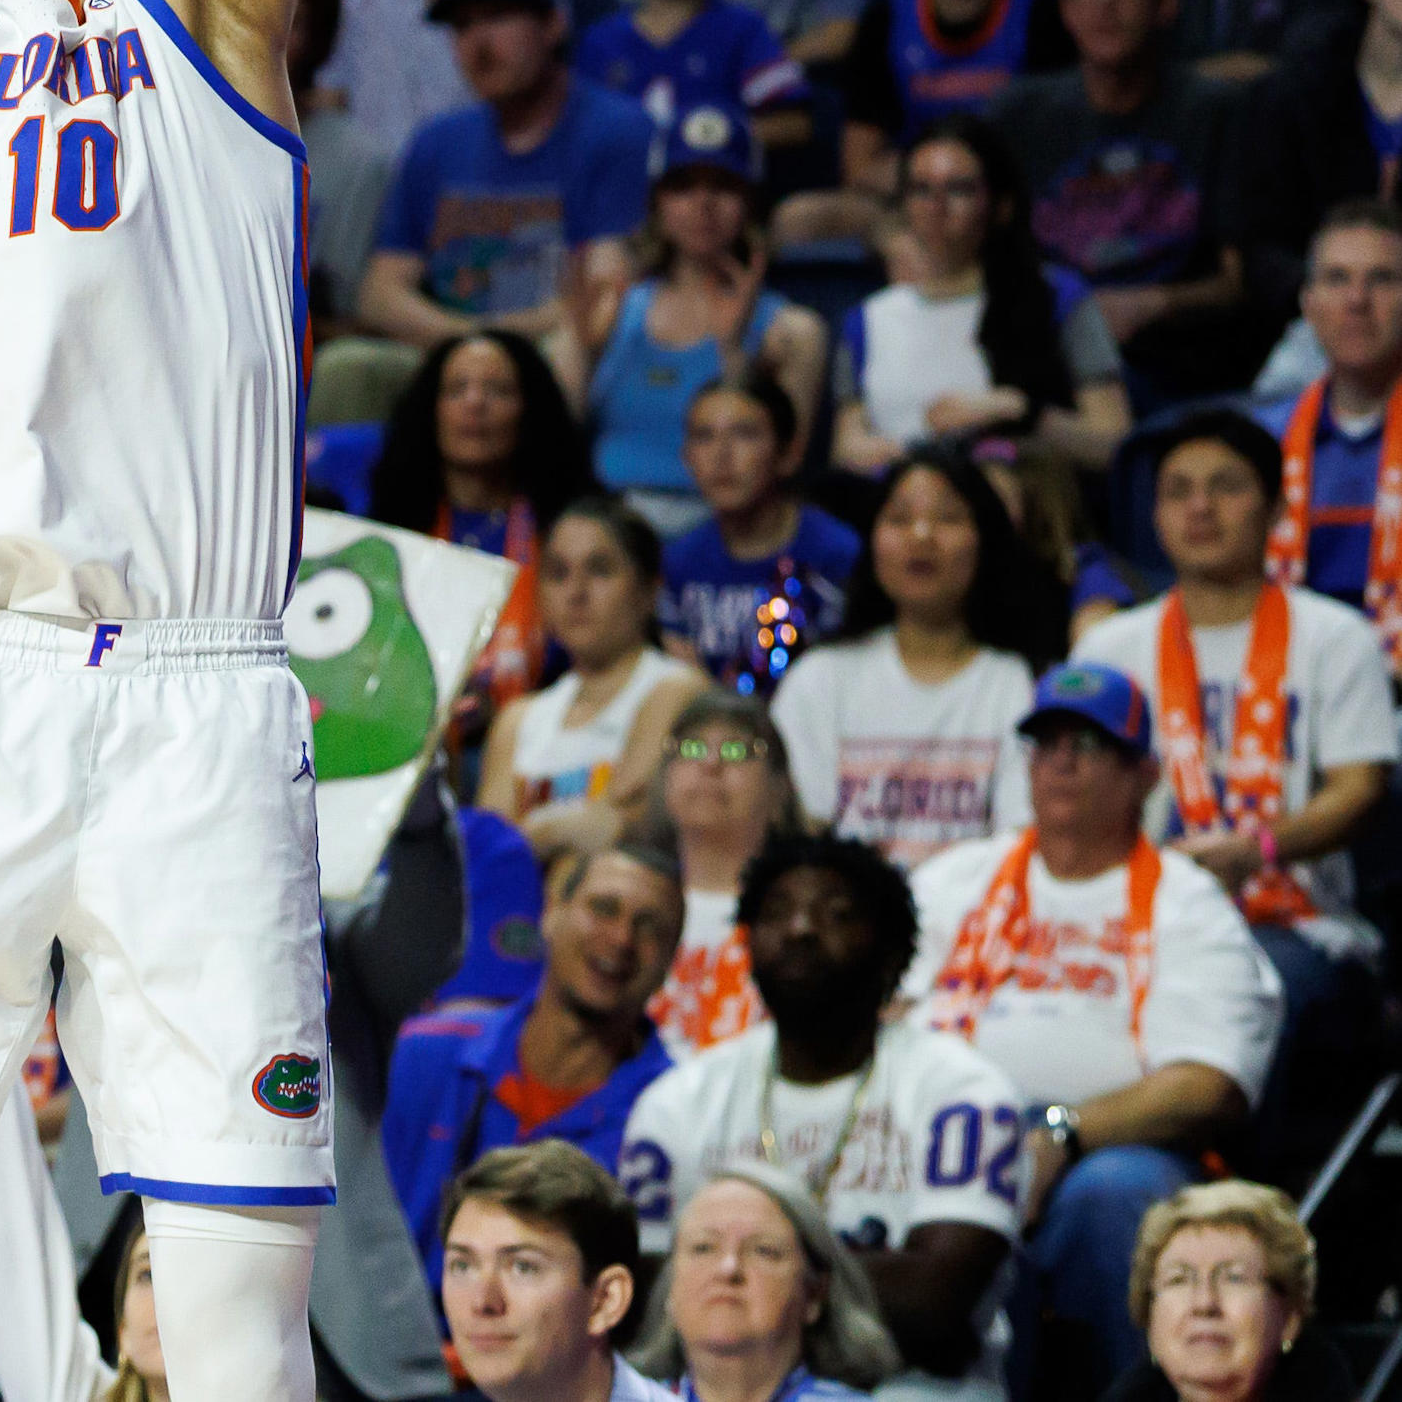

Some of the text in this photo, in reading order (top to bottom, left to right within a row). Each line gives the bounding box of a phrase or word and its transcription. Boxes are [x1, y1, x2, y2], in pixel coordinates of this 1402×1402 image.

[9, 115, 121, 238] 10
[84, 623, 122, 667] F
[926, 1102, 1019, 1205] 02
